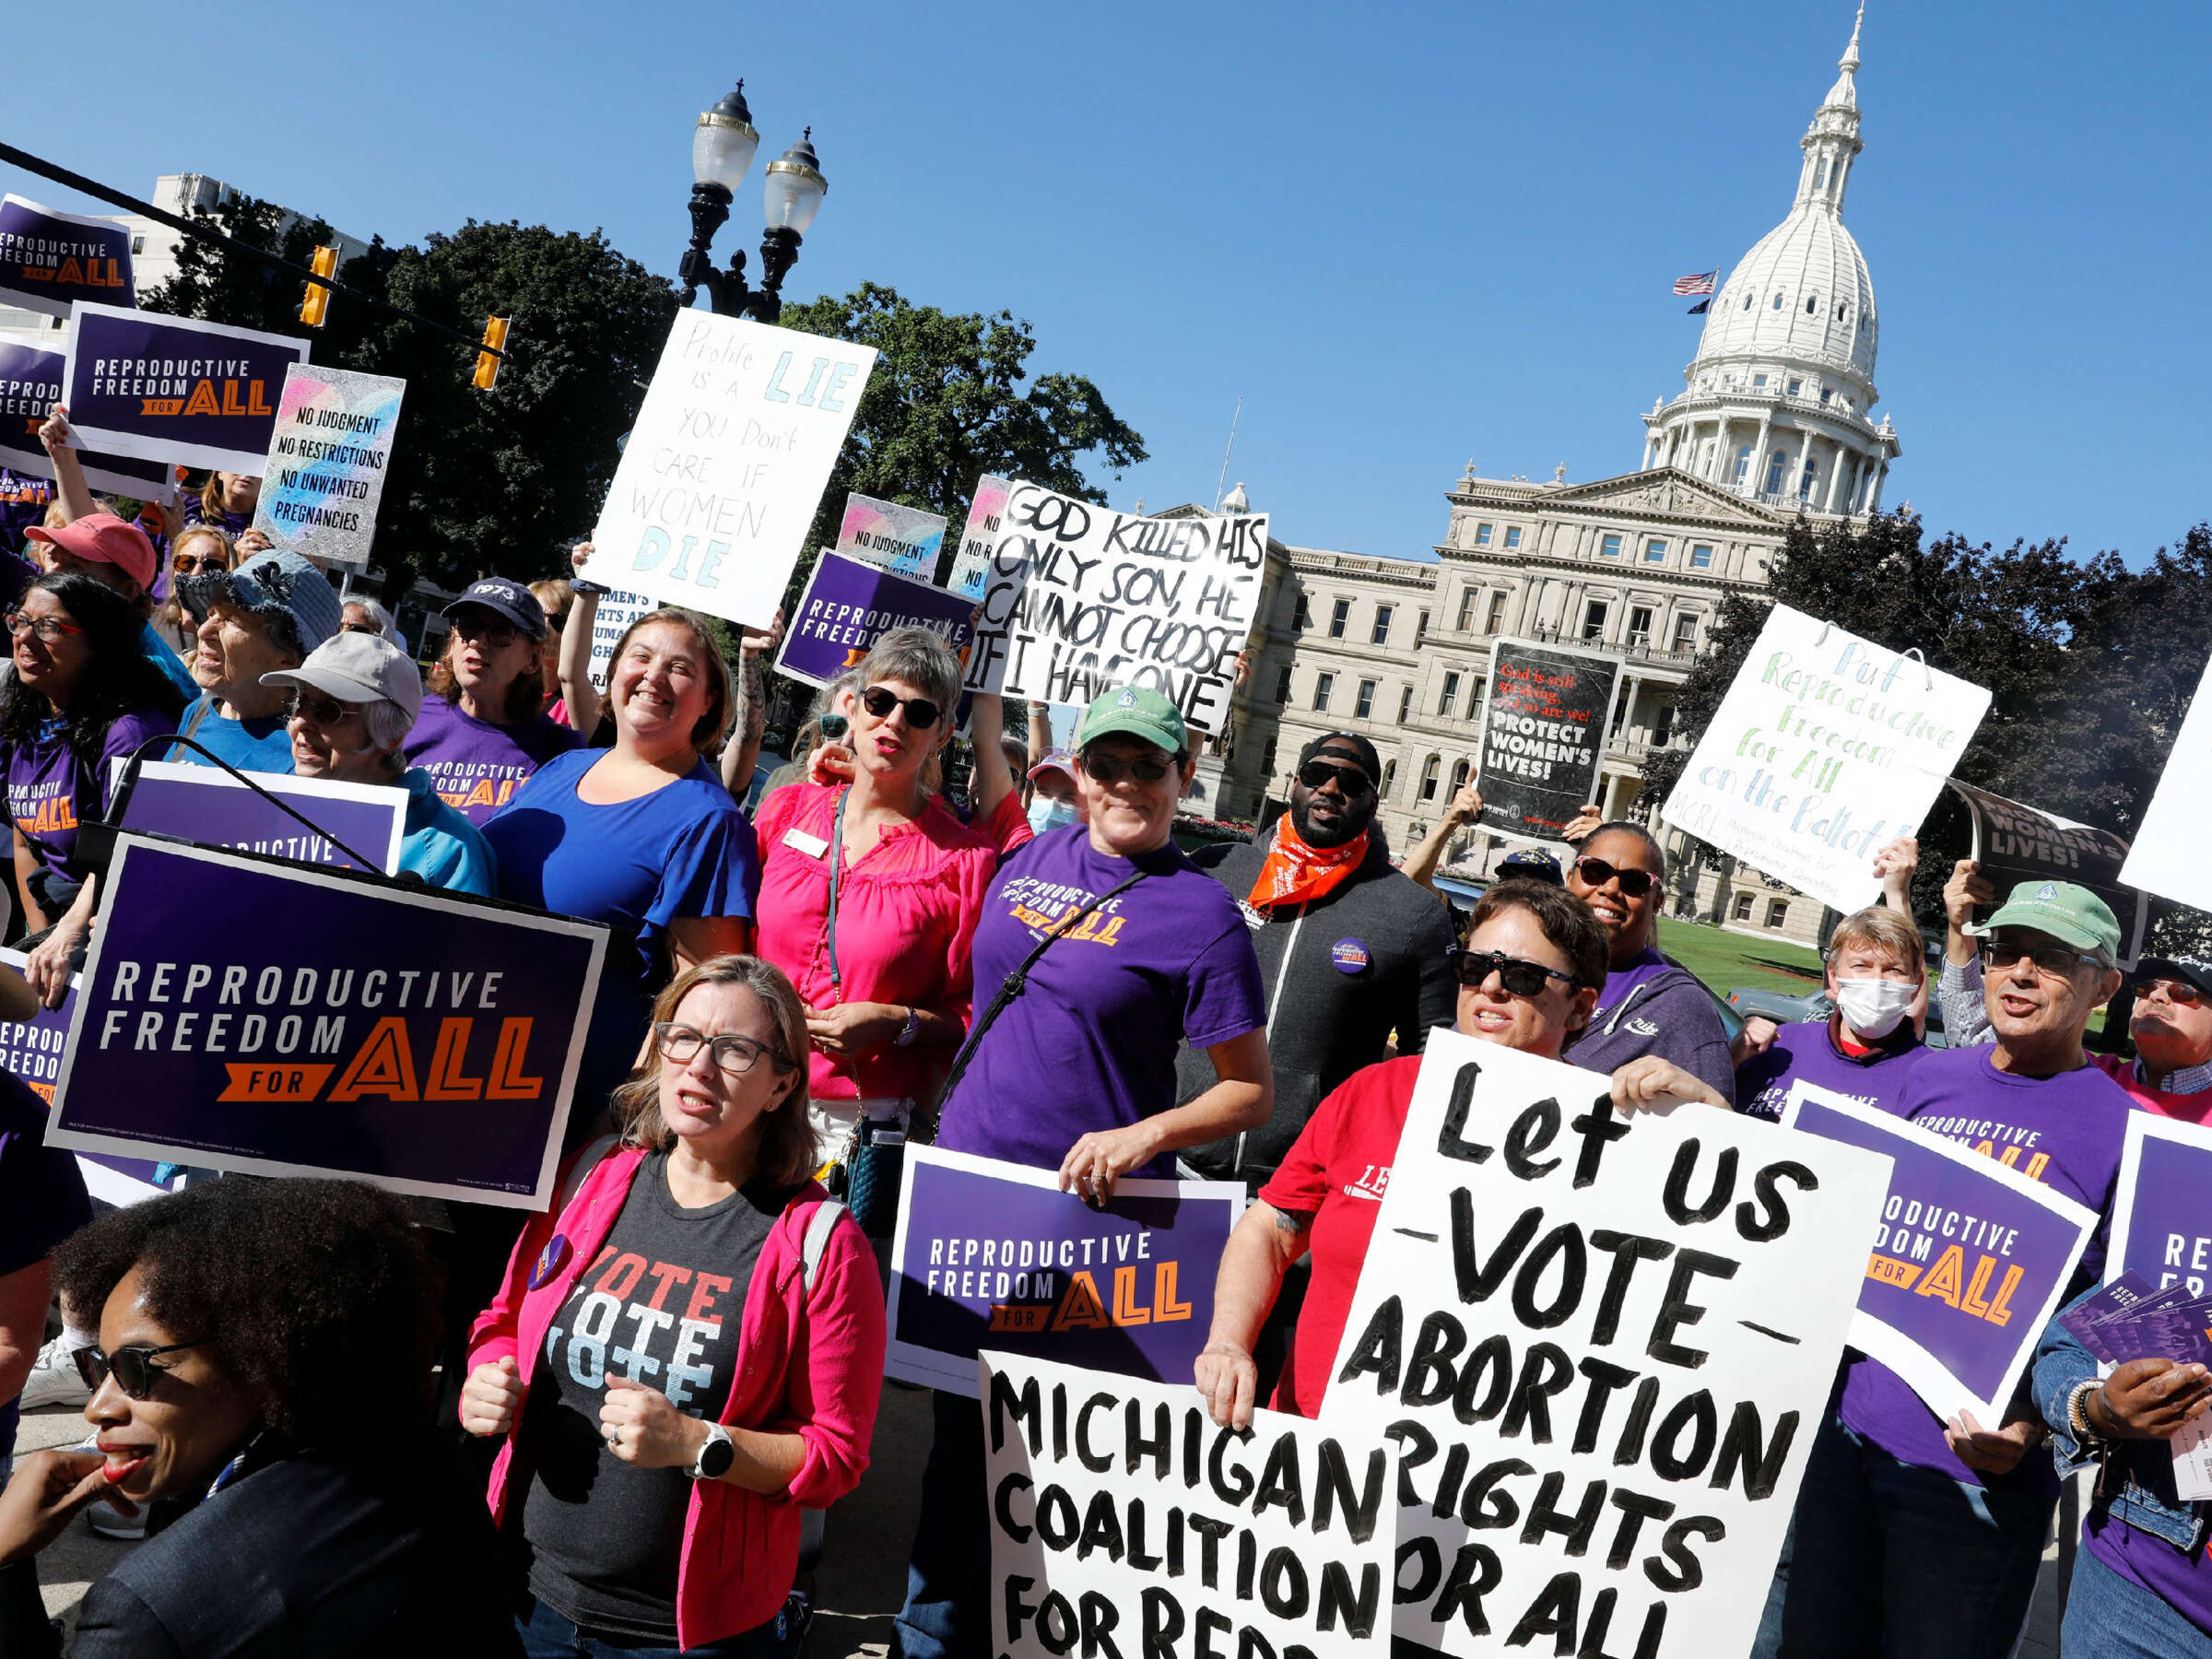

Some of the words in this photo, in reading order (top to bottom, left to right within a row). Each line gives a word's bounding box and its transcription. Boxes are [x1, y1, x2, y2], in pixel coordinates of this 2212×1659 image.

[0, 248, 58, 267] EEDOM
[56, 256, 125, 288] ALL
[95, 359, 250, 377] REPRODUCTIVE
[683, 320, 753, 371] Prolife
[764, 350, 859, 413] LIE
[93, 379, 187, 395] FREEDOM
[182, 379, 272, 417] ALL
[724, 378, 738, 399] A
[0, 399, 53, 417] EEDO
[150, 401, 173, 413] FOR
[296, 407, 312, 426] NO
[317, 408, 381, 435] JUDGMENT
[677, 407, 728, 441] YOU
[276, 436, 294, 455] NO
[298, 438, 384, 470] RESTRICTIONS
[652, 447, 713, 484] CARE
[740, 463, 769, 489] IF
[280, 469, 297, 488] NO
[300, 472, 369, 500] UNWANTED
[276, 500, 359, 533] PREGNANCIES
[630, 482, 768, 539] WOMEN
[983, 513, 999, 533] NO
[1006, 485, 1091, 542] GOD
[1102, 514, 1211, 563] KILLED
[1214, 517, 1266, 570] HIS
[630, 524, 733, 589] DIE
[854, 530, 869, 546] NO
[872, 533, 926, 562] JUDGMENT
[965, 538, 982, 557] NO
[473, 583, 515, 600] 1973
[965, 569, 982, 587] NO
[994, 534, 1103, 594] ONLY
[1099, 562, 1187, 618] SON,
[1195, 574, 1254, 624] HE
[983, 582, 1125, 649] CANNOT
[1120, 614, 1246, 683] CHOOSE
[963, 629, 1007, 689] IF
[1005, 634, 1036, 695] I
[1044, 642, 1135, 705] HAVE
[1127, 665, 1225, 731] ONE
[1500, 663, 1531, 682] God
[1533, 669, 1545, 685] is
[1547, 672, 1576, 690] still
[1834, 641, 1905, 693] Put
[1523, 702, 1538, 713] so
[1540, 707, 1564, 719] are
[1566, 710, 1592, 724] we!
[1761, 651, 1957, 750] Reproductive
[1492, 711, 1586, 744] PROTECT
[1776, 704, 1898, 771] Freedom
[1486, 749, 1552, 781] LIVES!
[1489, 729, 1593, 767] WOMEN'S
[1735, 726, 1785, 764] for
[1790, 749, 1845, 794] All
[462, 776, 530, 807] AL
[1698, 765, 1738, 794] on
[1743, 768, 1791, 814] the
[34, 795, 79, 833] ALL
[1985, 810, 2123, 861] WOMEN'S
[1991, 831, 2080, 869] LIVES!
[112, 960, 504, 1009] REPRODUCTIVE
[99, 1010, 347, 1055] FREEDOM
[325, 1016, 544, 1103] ALL
[248, 1070, 304, 1094] FOR
[1437, 1062, 1631, 1190] Let
[929, 1231, 1152, 1268] REPRODUCTIVE
[927, 1269, 1053, 1300] FREEDOM
[1872, 1259, 1906, 1283] FOR
[1914, 1243, 2026, 1327] ALL
[1050, 1260, 1193, 1333] ALL
[1003, 1310, 1035, 1327] FOR
[1339, 1294, 1800, 1501] ABORTION
[989, 1370, 1387, 1546] MICHIGAN
[1384, 1419, 1726, 1593] RIGHTS
[994, 1472, 1382, 1640] COALITION
[1005, 1573, 1124, 1659] FOR
